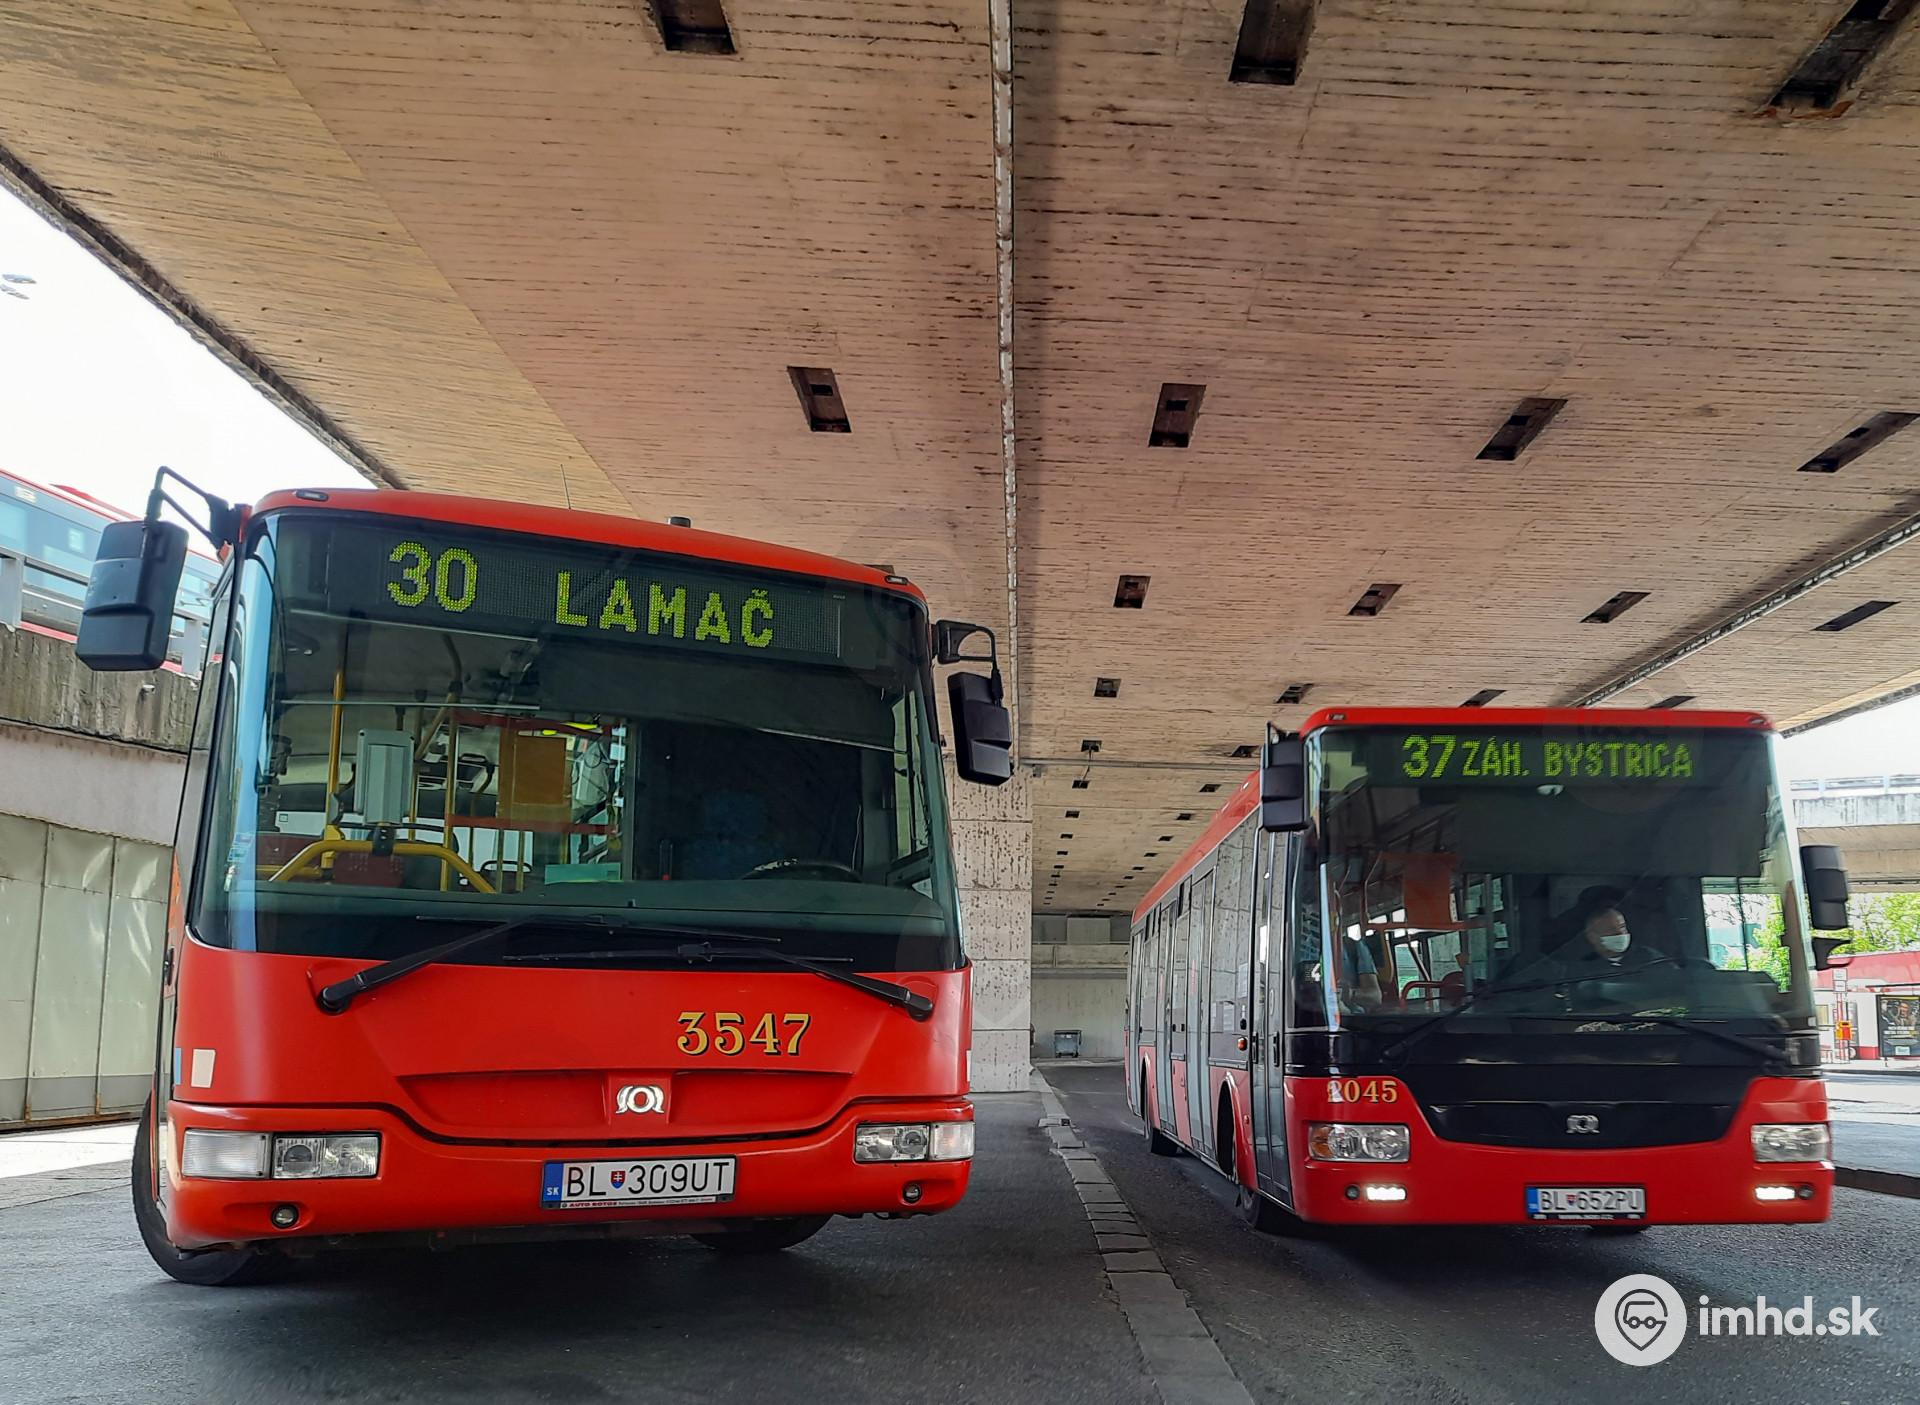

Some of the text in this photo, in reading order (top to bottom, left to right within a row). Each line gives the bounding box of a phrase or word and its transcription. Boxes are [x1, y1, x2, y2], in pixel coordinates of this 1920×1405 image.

[387, 541, 774, 648] 30 LAMAČ
[1402, 734, 1693, 778] 37 ZÁH. BYSTRICA
[676, 1011, 812, 1056] 3547
[546, 1186, 560, 1196] SK
